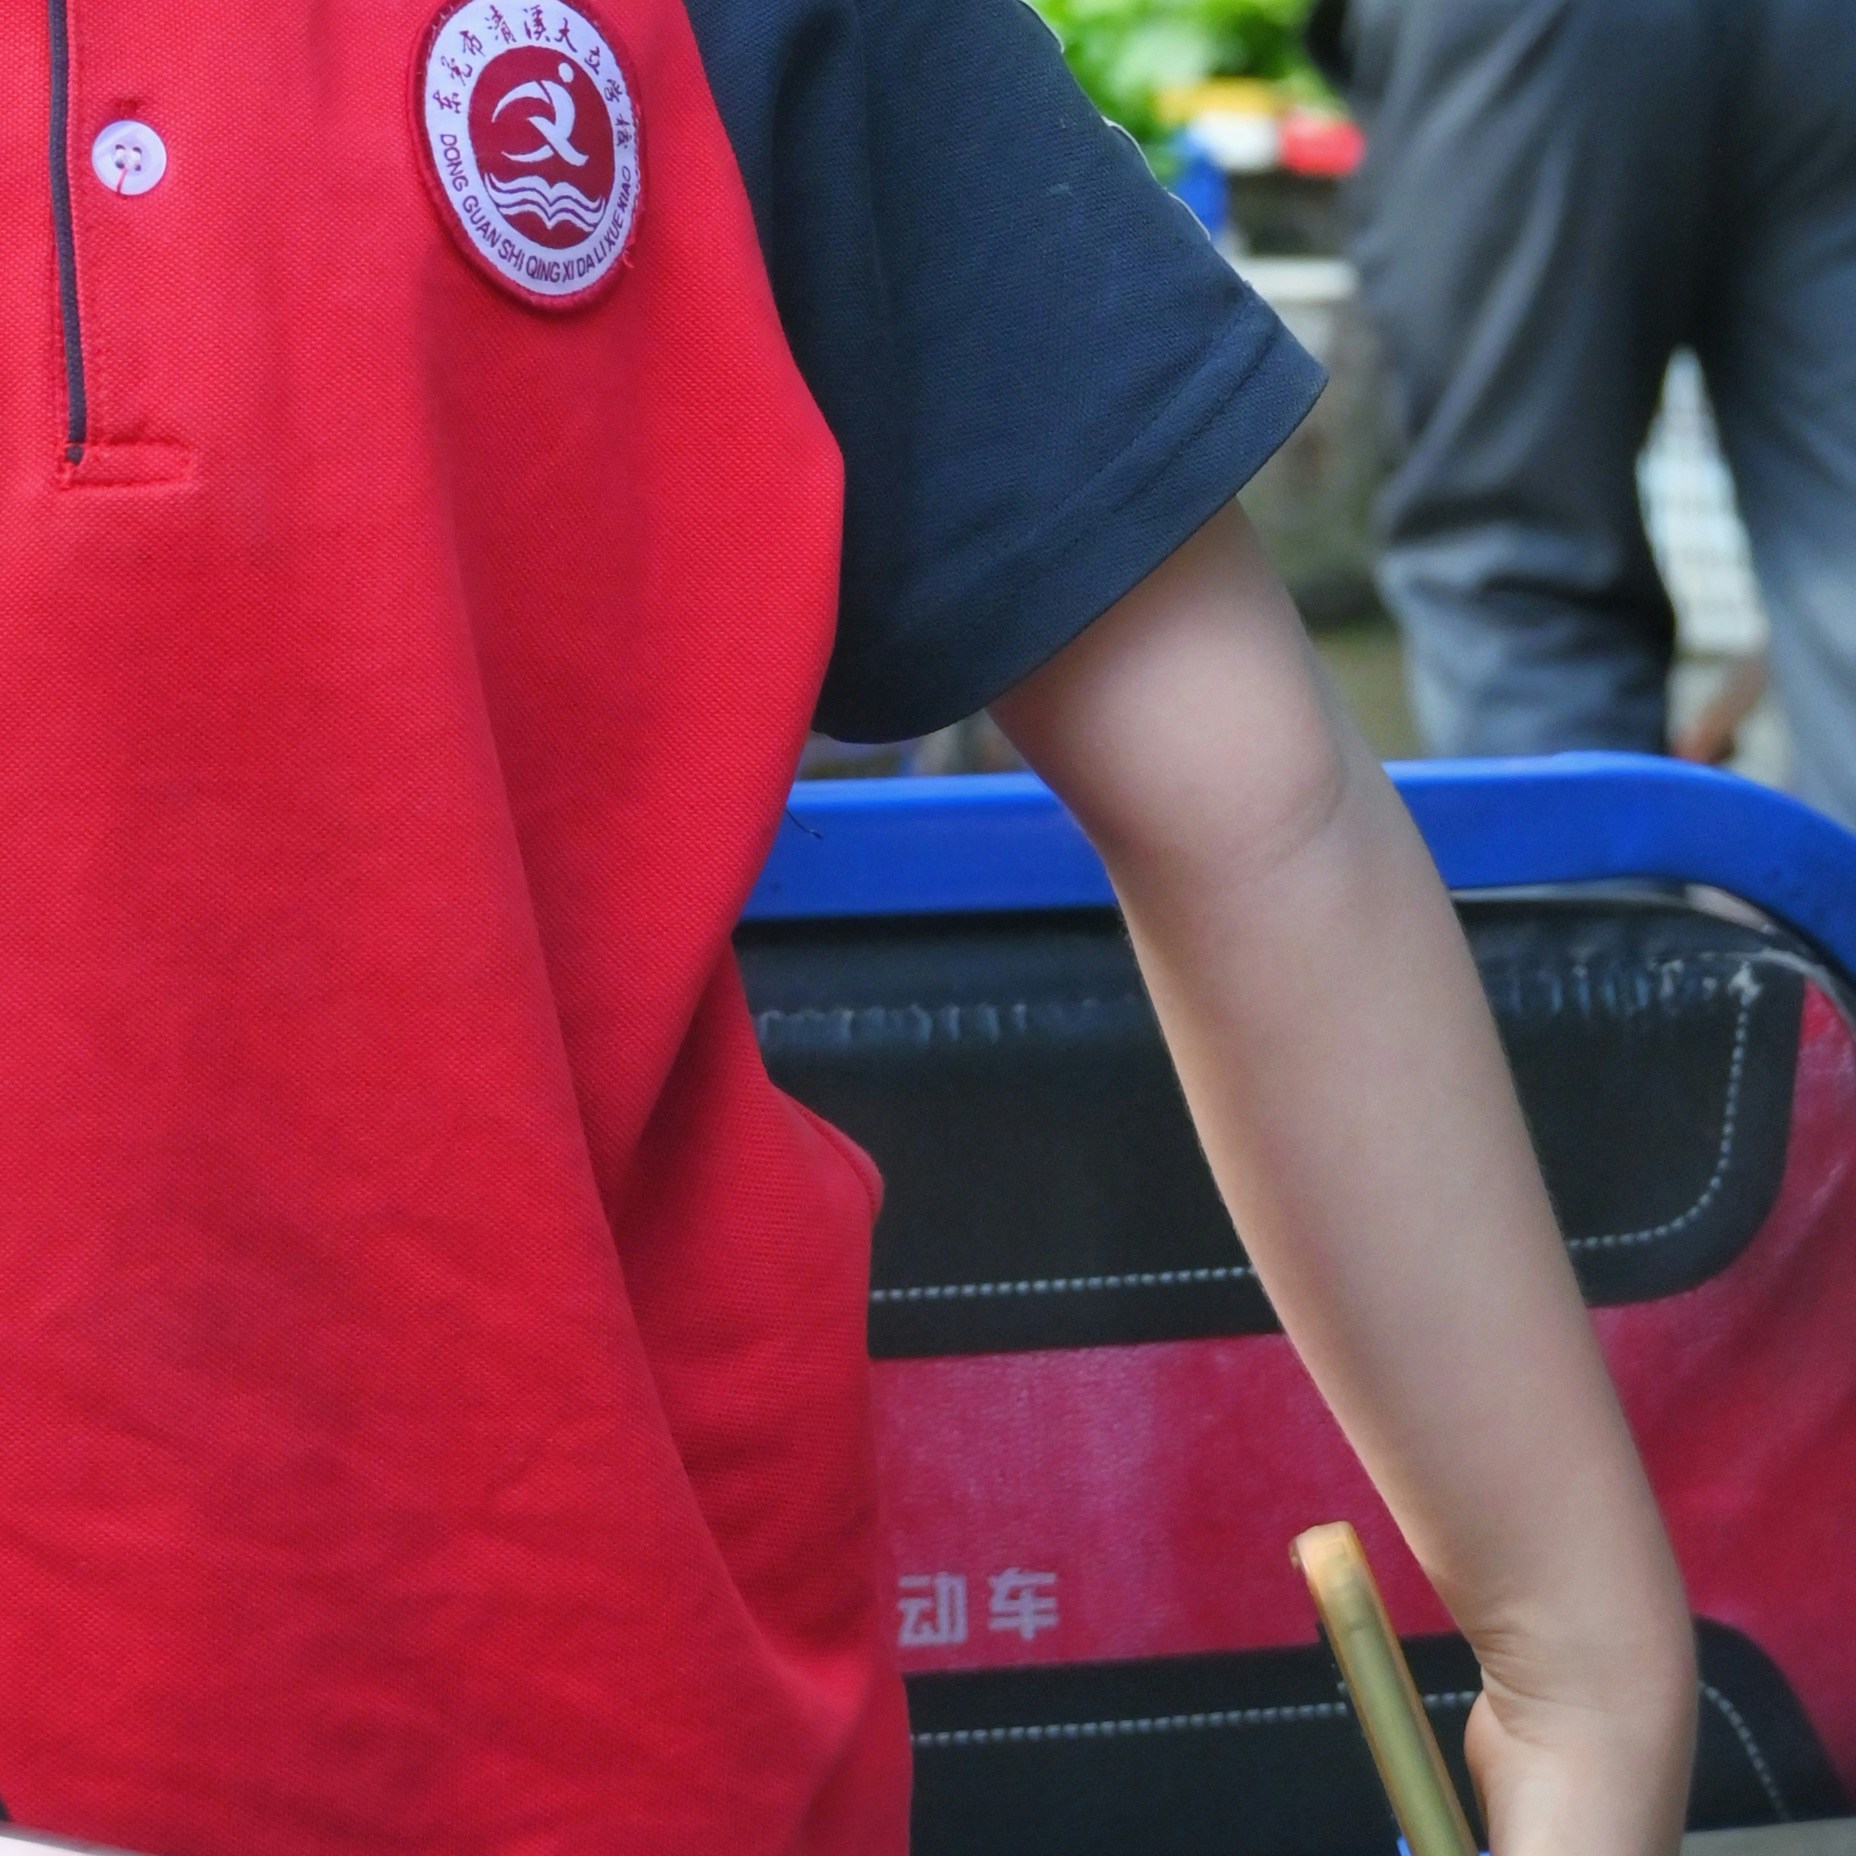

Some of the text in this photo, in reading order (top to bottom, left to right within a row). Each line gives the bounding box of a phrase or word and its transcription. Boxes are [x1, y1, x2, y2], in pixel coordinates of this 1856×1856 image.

[440, 133, 632, 283] DONG GUAN SHI QING XI DA LI XUE XIAO
[896, 1566, 1058, 1649] 动车
